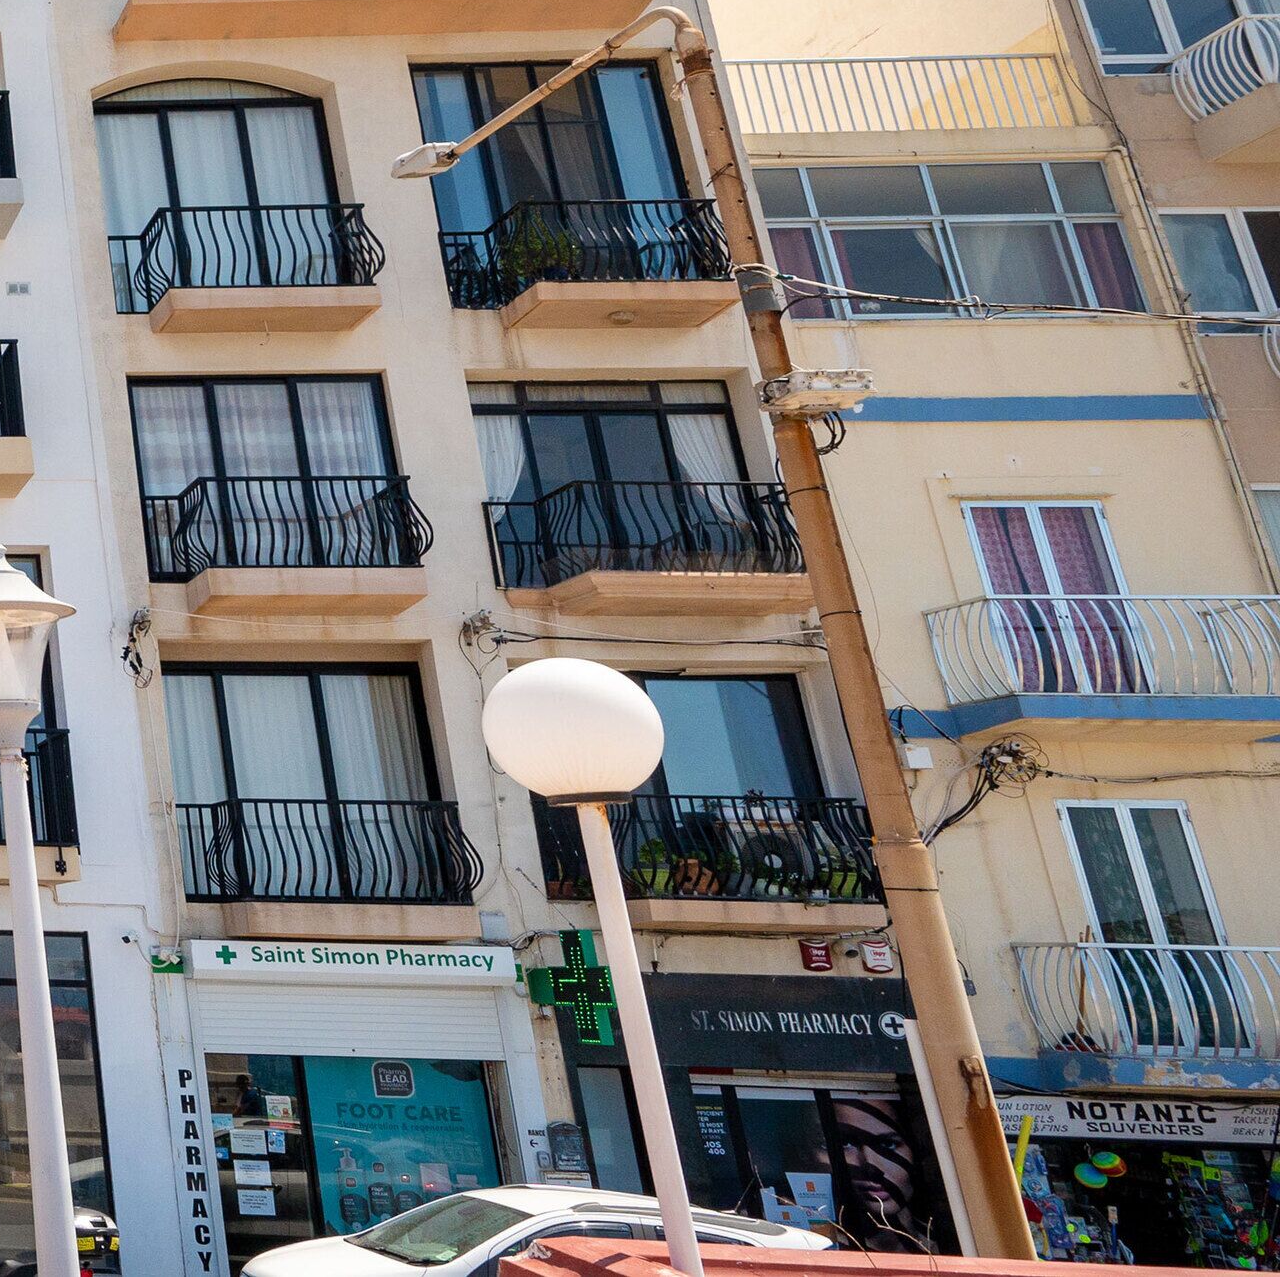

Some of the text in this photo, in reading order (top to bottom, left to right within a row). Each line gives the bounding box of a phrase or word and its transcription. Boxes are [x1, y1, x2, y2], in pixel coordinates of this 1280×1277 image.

[251, 946, 494, 971] Saint Simon Pharmacy
[691, 1010, 872, 1035] ST. SIMON PHARMACY
[336, 1103, 463, 1121] FOOT CARE
[998, 1103, 1052, 1111] UN LOTION
[1066, 1101, 1217, 1123] NOTANIC
[1242, 1107, 1278, 1115] FISHIN
[1233, 1116, 1269, 1124] TACKLE
[1040, 1124, 1069, 1132] FINS
[1086, 1122, 1205, 1136] SOUVENIRS
[1232, 1127, 1266, 1136] BEACH
[178, 1069, 212, 1272] PHARMACY
